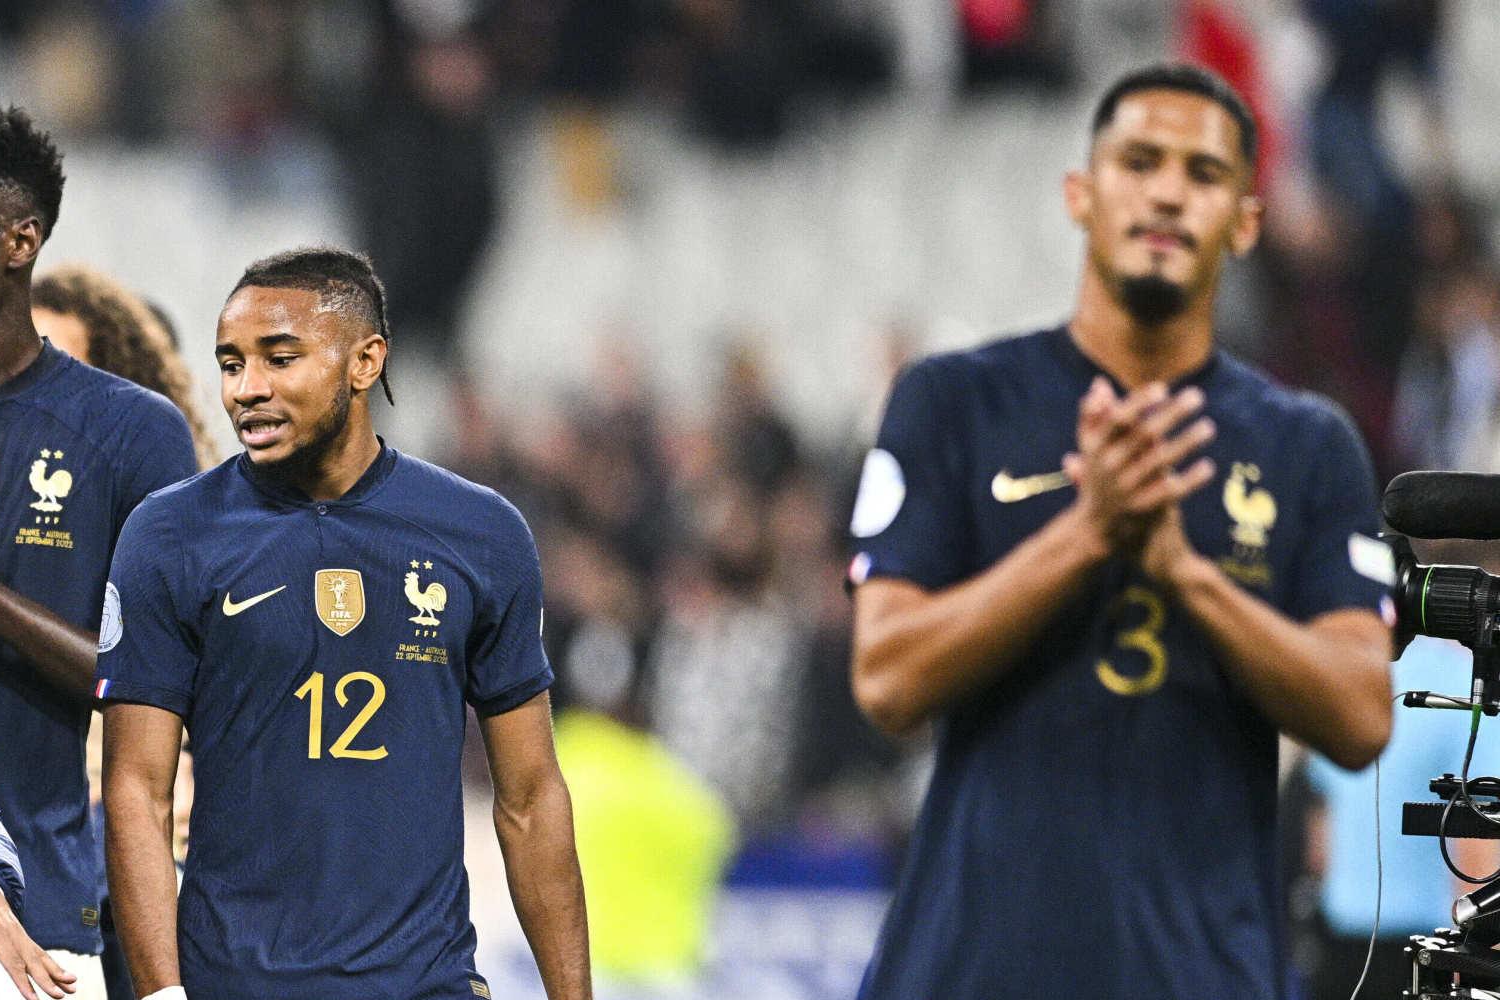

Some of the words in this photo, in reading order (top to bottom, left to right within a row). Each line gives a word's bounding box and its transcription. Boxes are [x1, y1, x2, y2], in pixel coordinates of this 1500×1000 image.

[395, 652, 404, 660] 22
[399, 643, 420, 653] FRANCE
[1097, 586, 1166, 691] 3
[293, 671, 389, 760] 12
